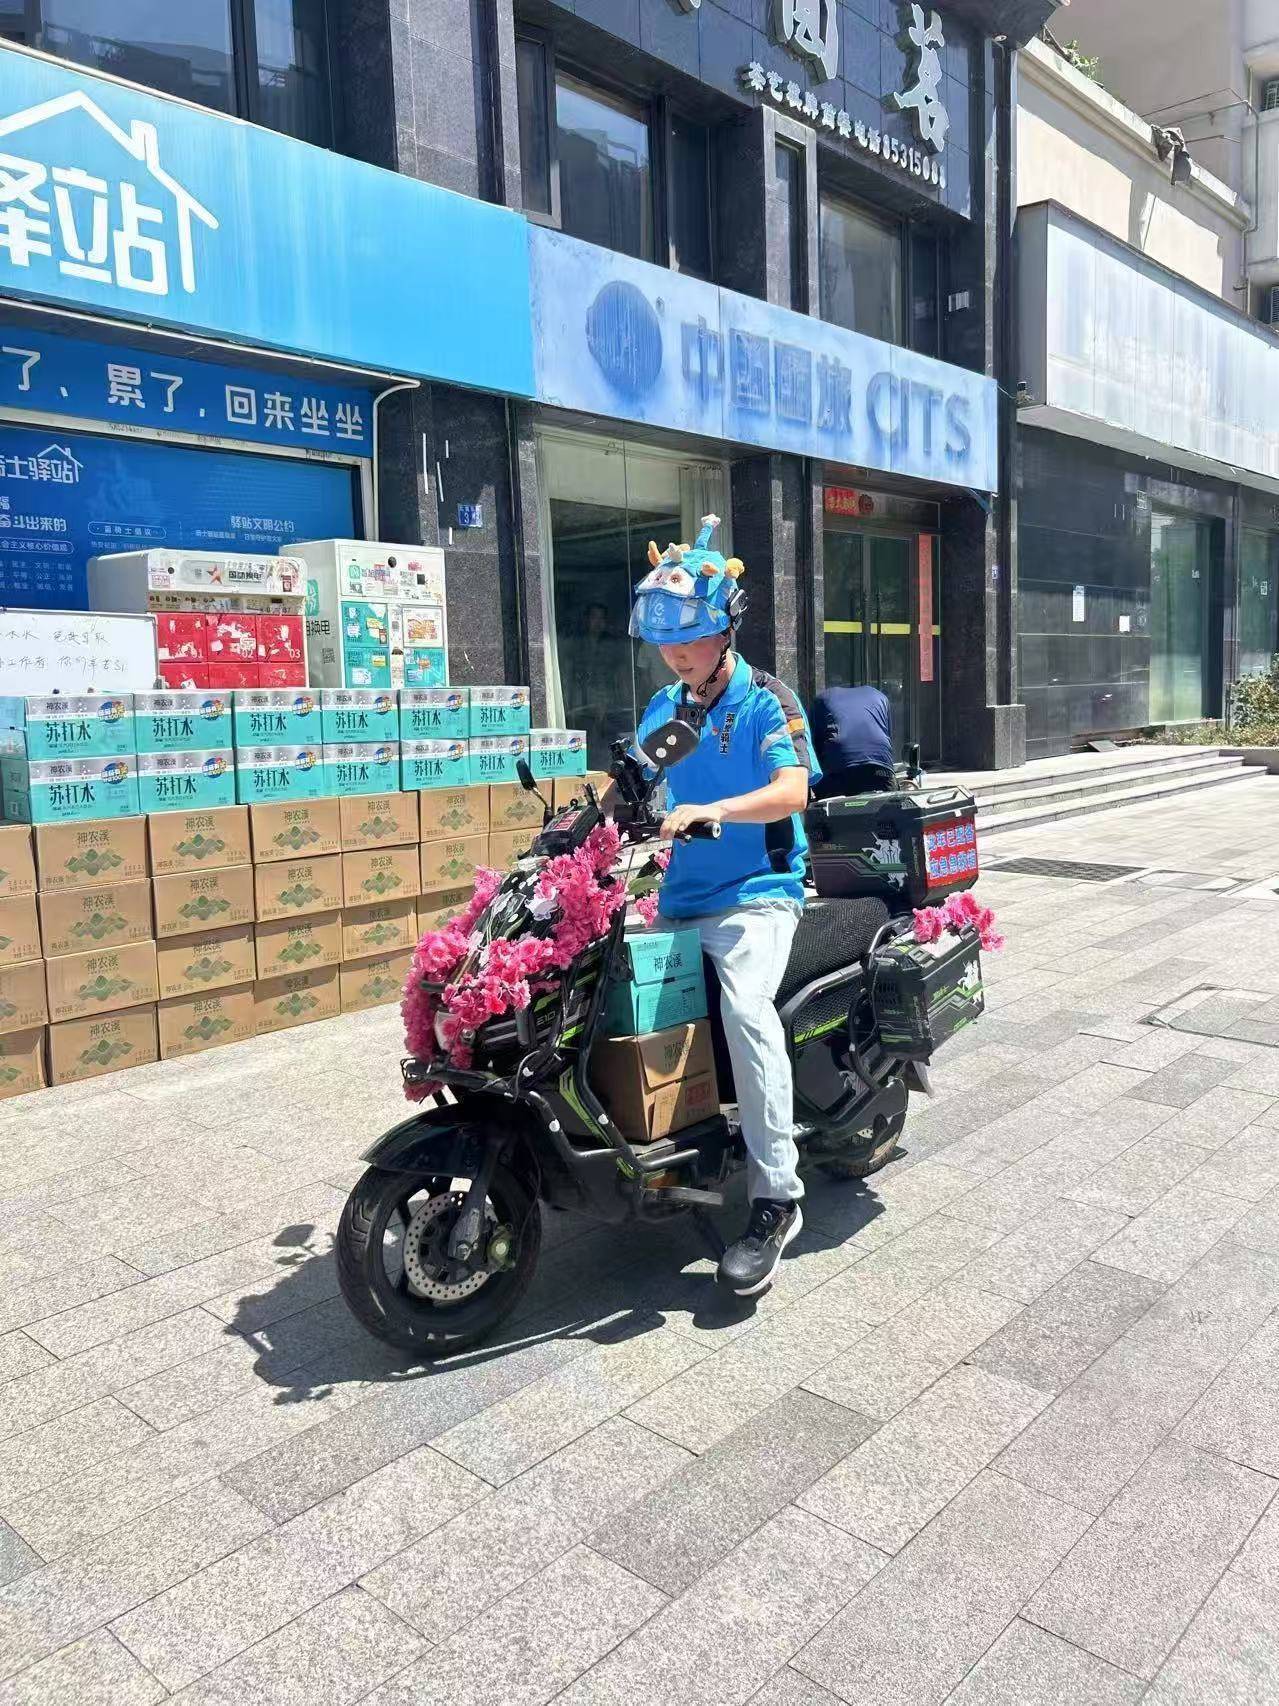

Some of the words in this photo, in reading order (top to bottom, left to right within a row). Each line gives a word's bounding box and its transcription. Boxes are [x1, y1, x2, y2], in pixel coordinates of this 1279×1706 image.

[866, 371, 972, 462] CITS
[0, 514, 67, 533] 奋斗出来的
[230, 515, 295, 533] 驿站文明公约
[289, 648, 302, 660] 03
[250, 713, 288, 732] 苏打水
[335, 711, 369, 730] 苏打水
[411, 710, 442, 727] 苏打水
[480, 707, 506, 723] 苏打水
[46, 721, 92, 743] 苏打水
[152, 717, 194, 737] 苏打水
[479, 755, 506, 771] 苏打水
[539, 750, 566, 766] 苏打水
[336, 763, 370, 782] 苏打水
[414, 759, 444, 777] 苏打水
[155, 775, 198, 797] 苏打水
[252, 768, 291, 788] 苏打水
[49, 783, 96, 806] 苏打水
[76, 829, 112, 845] 神农溪
[653, 953, 683, 973] 神农溪
